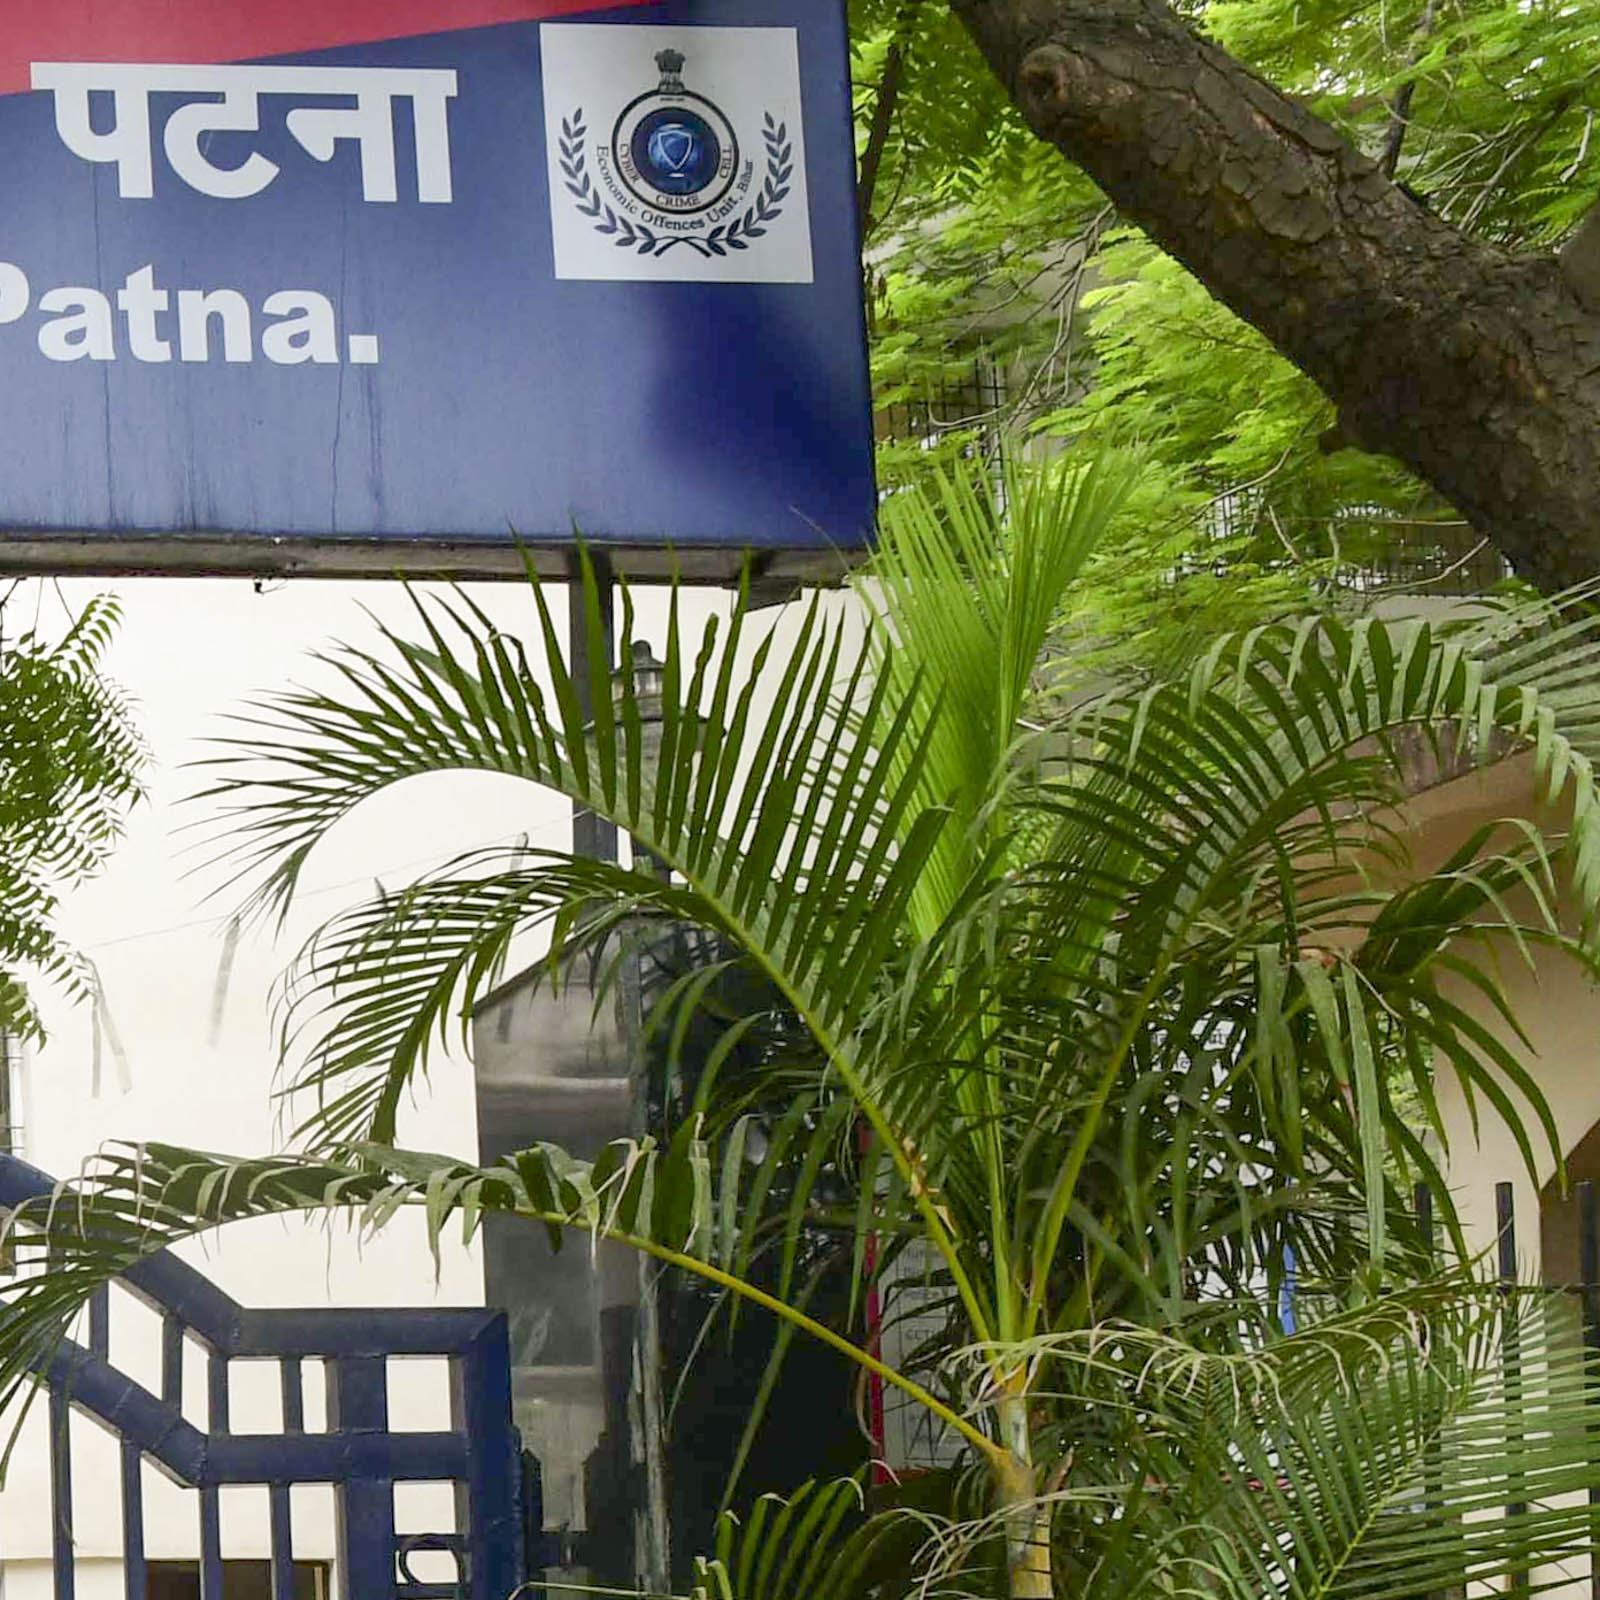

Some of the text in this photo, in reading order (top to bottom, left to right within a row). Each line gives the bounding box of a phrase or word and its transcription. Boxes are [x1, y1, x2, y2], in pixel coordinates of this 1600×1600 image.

[30, 62, 457, 202] पटना
[597, 145, 638, 214] Economic
[641, 209, 705, 231] Offences
[737, 159, 754, 193] Bihar
[655, 194, 700, 208] CRIME
